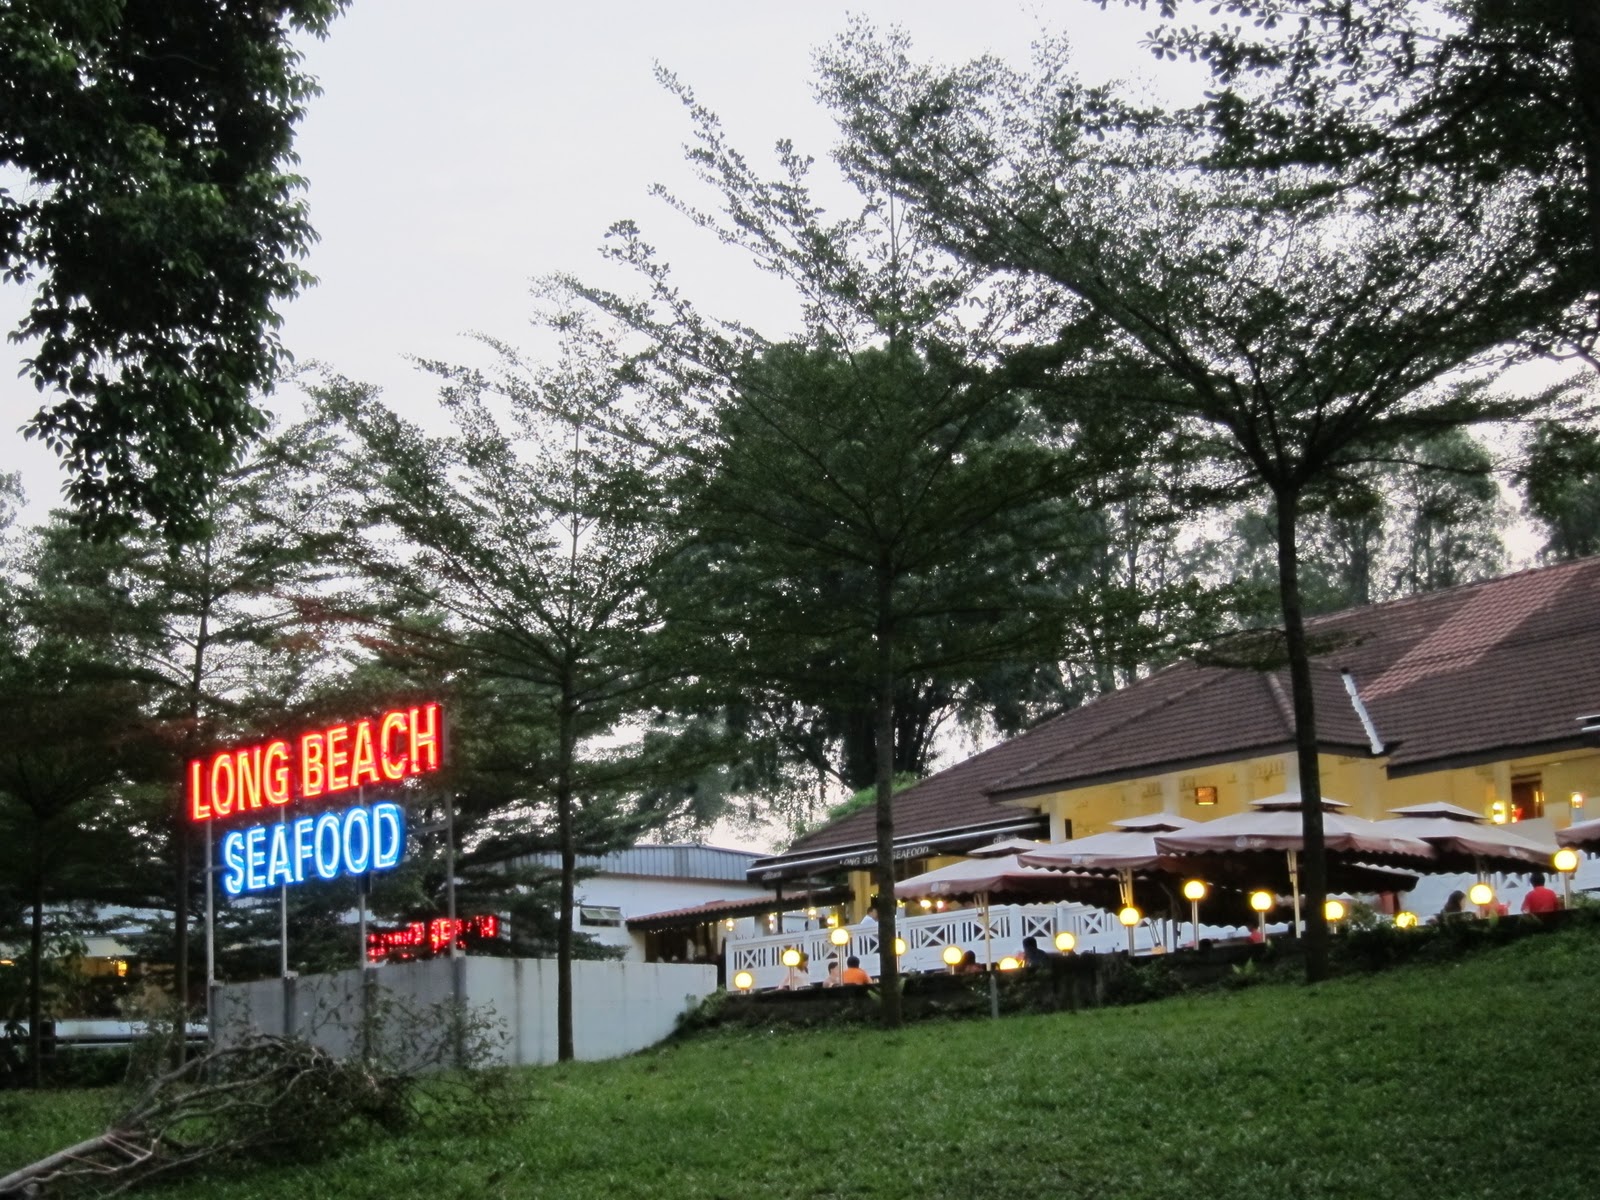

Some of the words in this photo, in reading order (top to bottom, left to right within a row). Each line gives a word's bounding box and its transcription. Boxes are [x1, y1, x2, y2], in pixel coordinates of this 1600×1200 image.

[190, 741, 290, 821] LONG
[301, 703, 439, 798] BEACH
[222, 802, 402, 896] SEAFOOD
